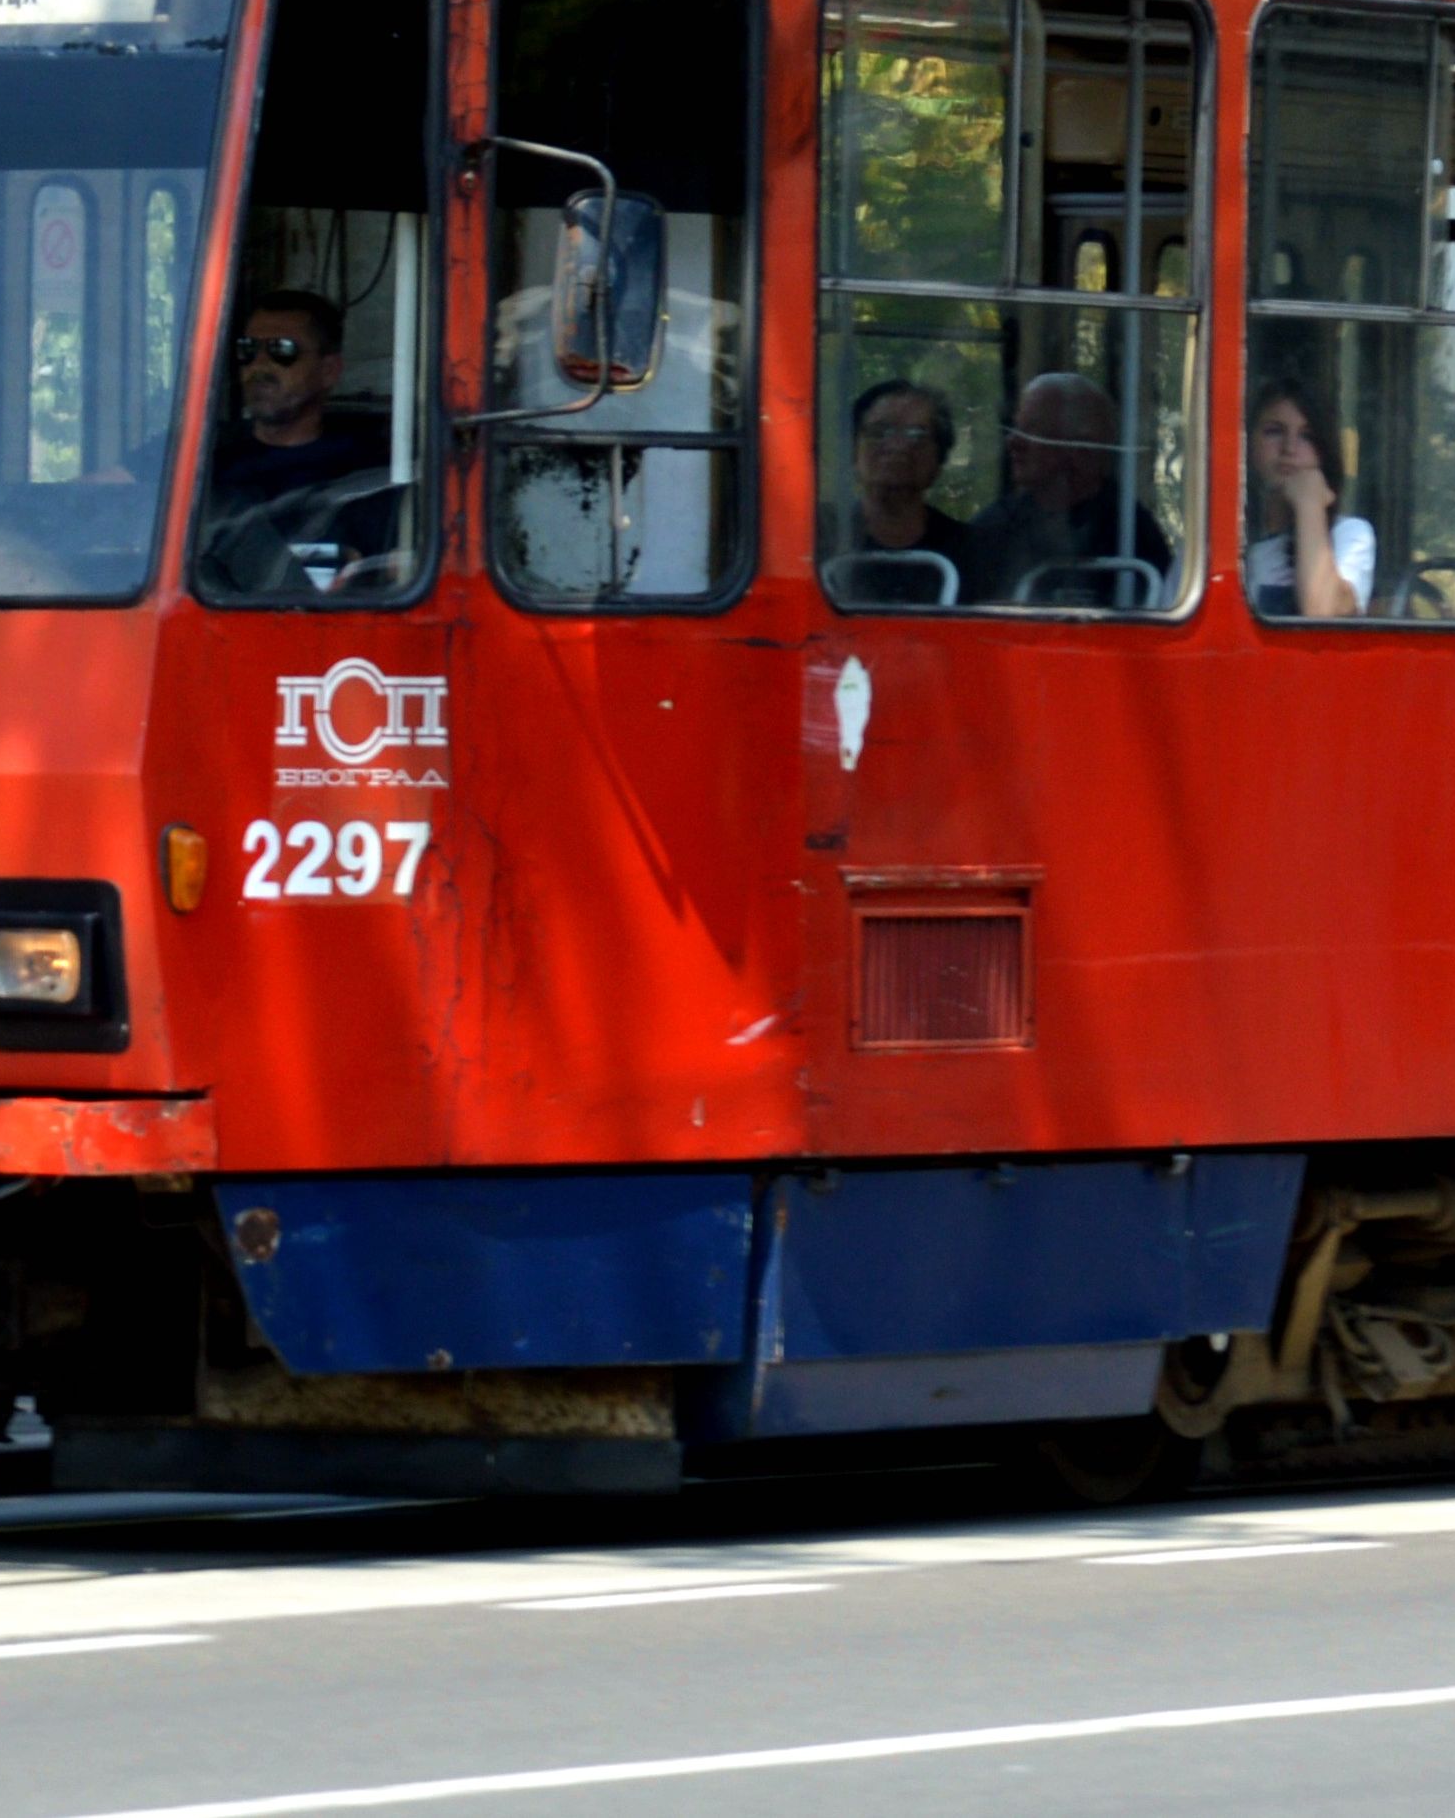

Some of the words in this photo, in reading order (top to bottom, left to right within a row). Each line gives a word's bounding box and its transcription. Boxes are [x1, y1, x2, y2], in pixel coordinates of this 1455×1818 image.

[275, 657, 448, 765] ГСП
[275, 768, 449, 789] БЕОГРАД
[242, 819, 431, 899] 2297
